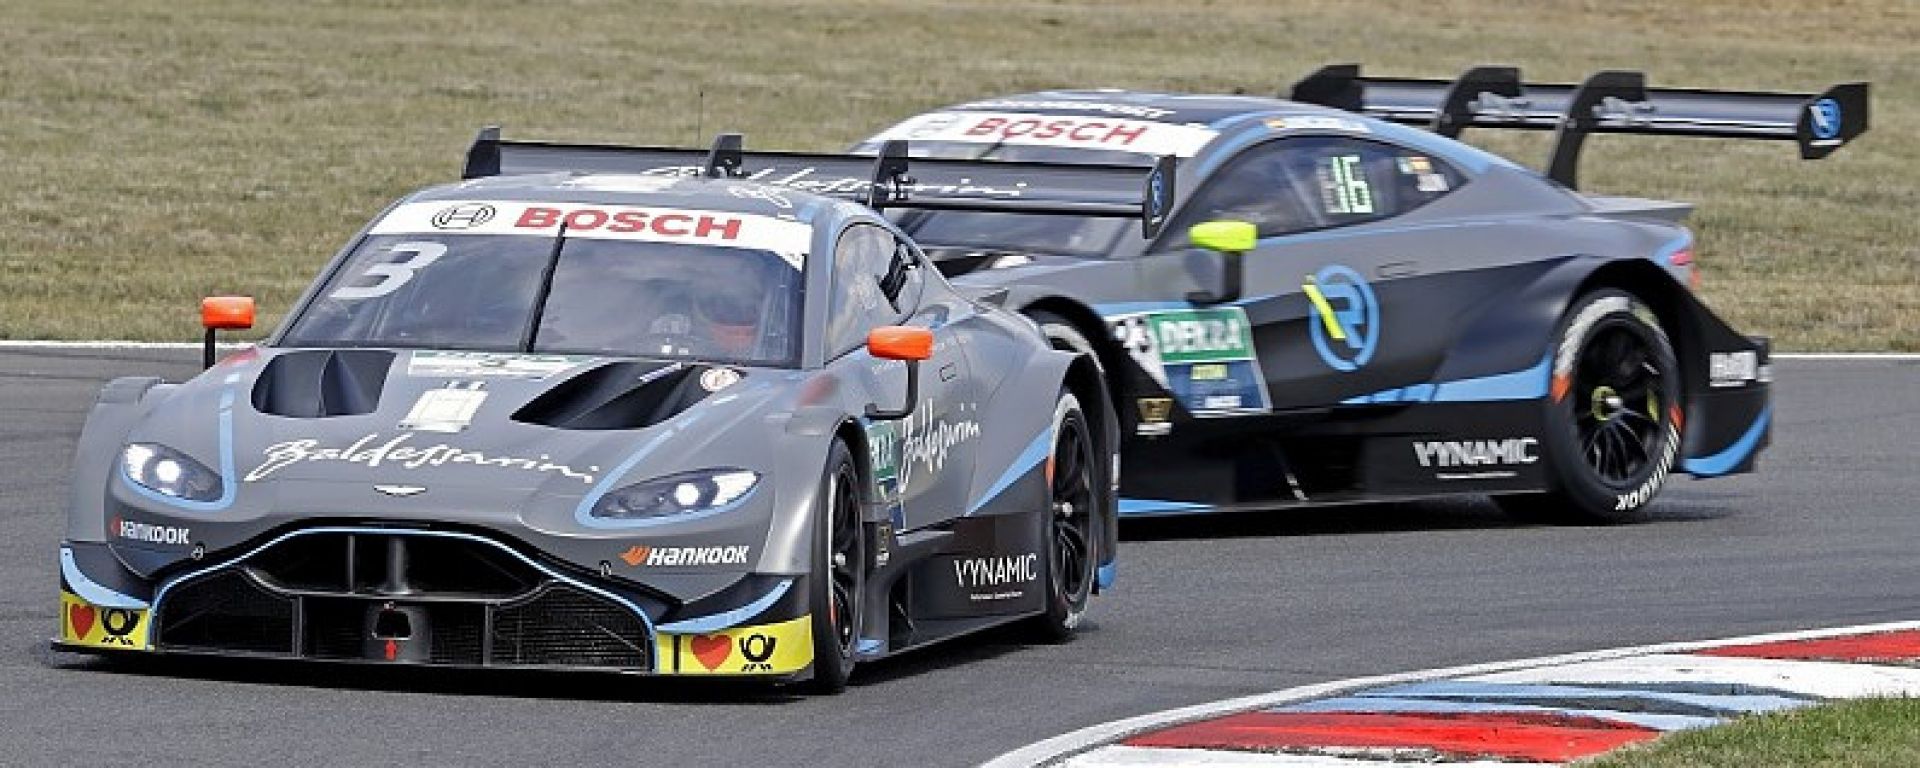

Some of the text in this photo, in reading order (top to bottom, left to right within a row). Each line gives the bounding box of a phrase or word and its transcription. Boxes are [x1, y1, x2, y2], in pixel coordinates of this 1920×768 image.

[965, 117, 1149, 146] BOSCH
[513, 206, 743, 240] BOSCH
[328, 241, 448, 299] 3
[1412, 437, 1540, 467] VYNAMIC
[953, 553, 1037, 588] VYNAMIC
